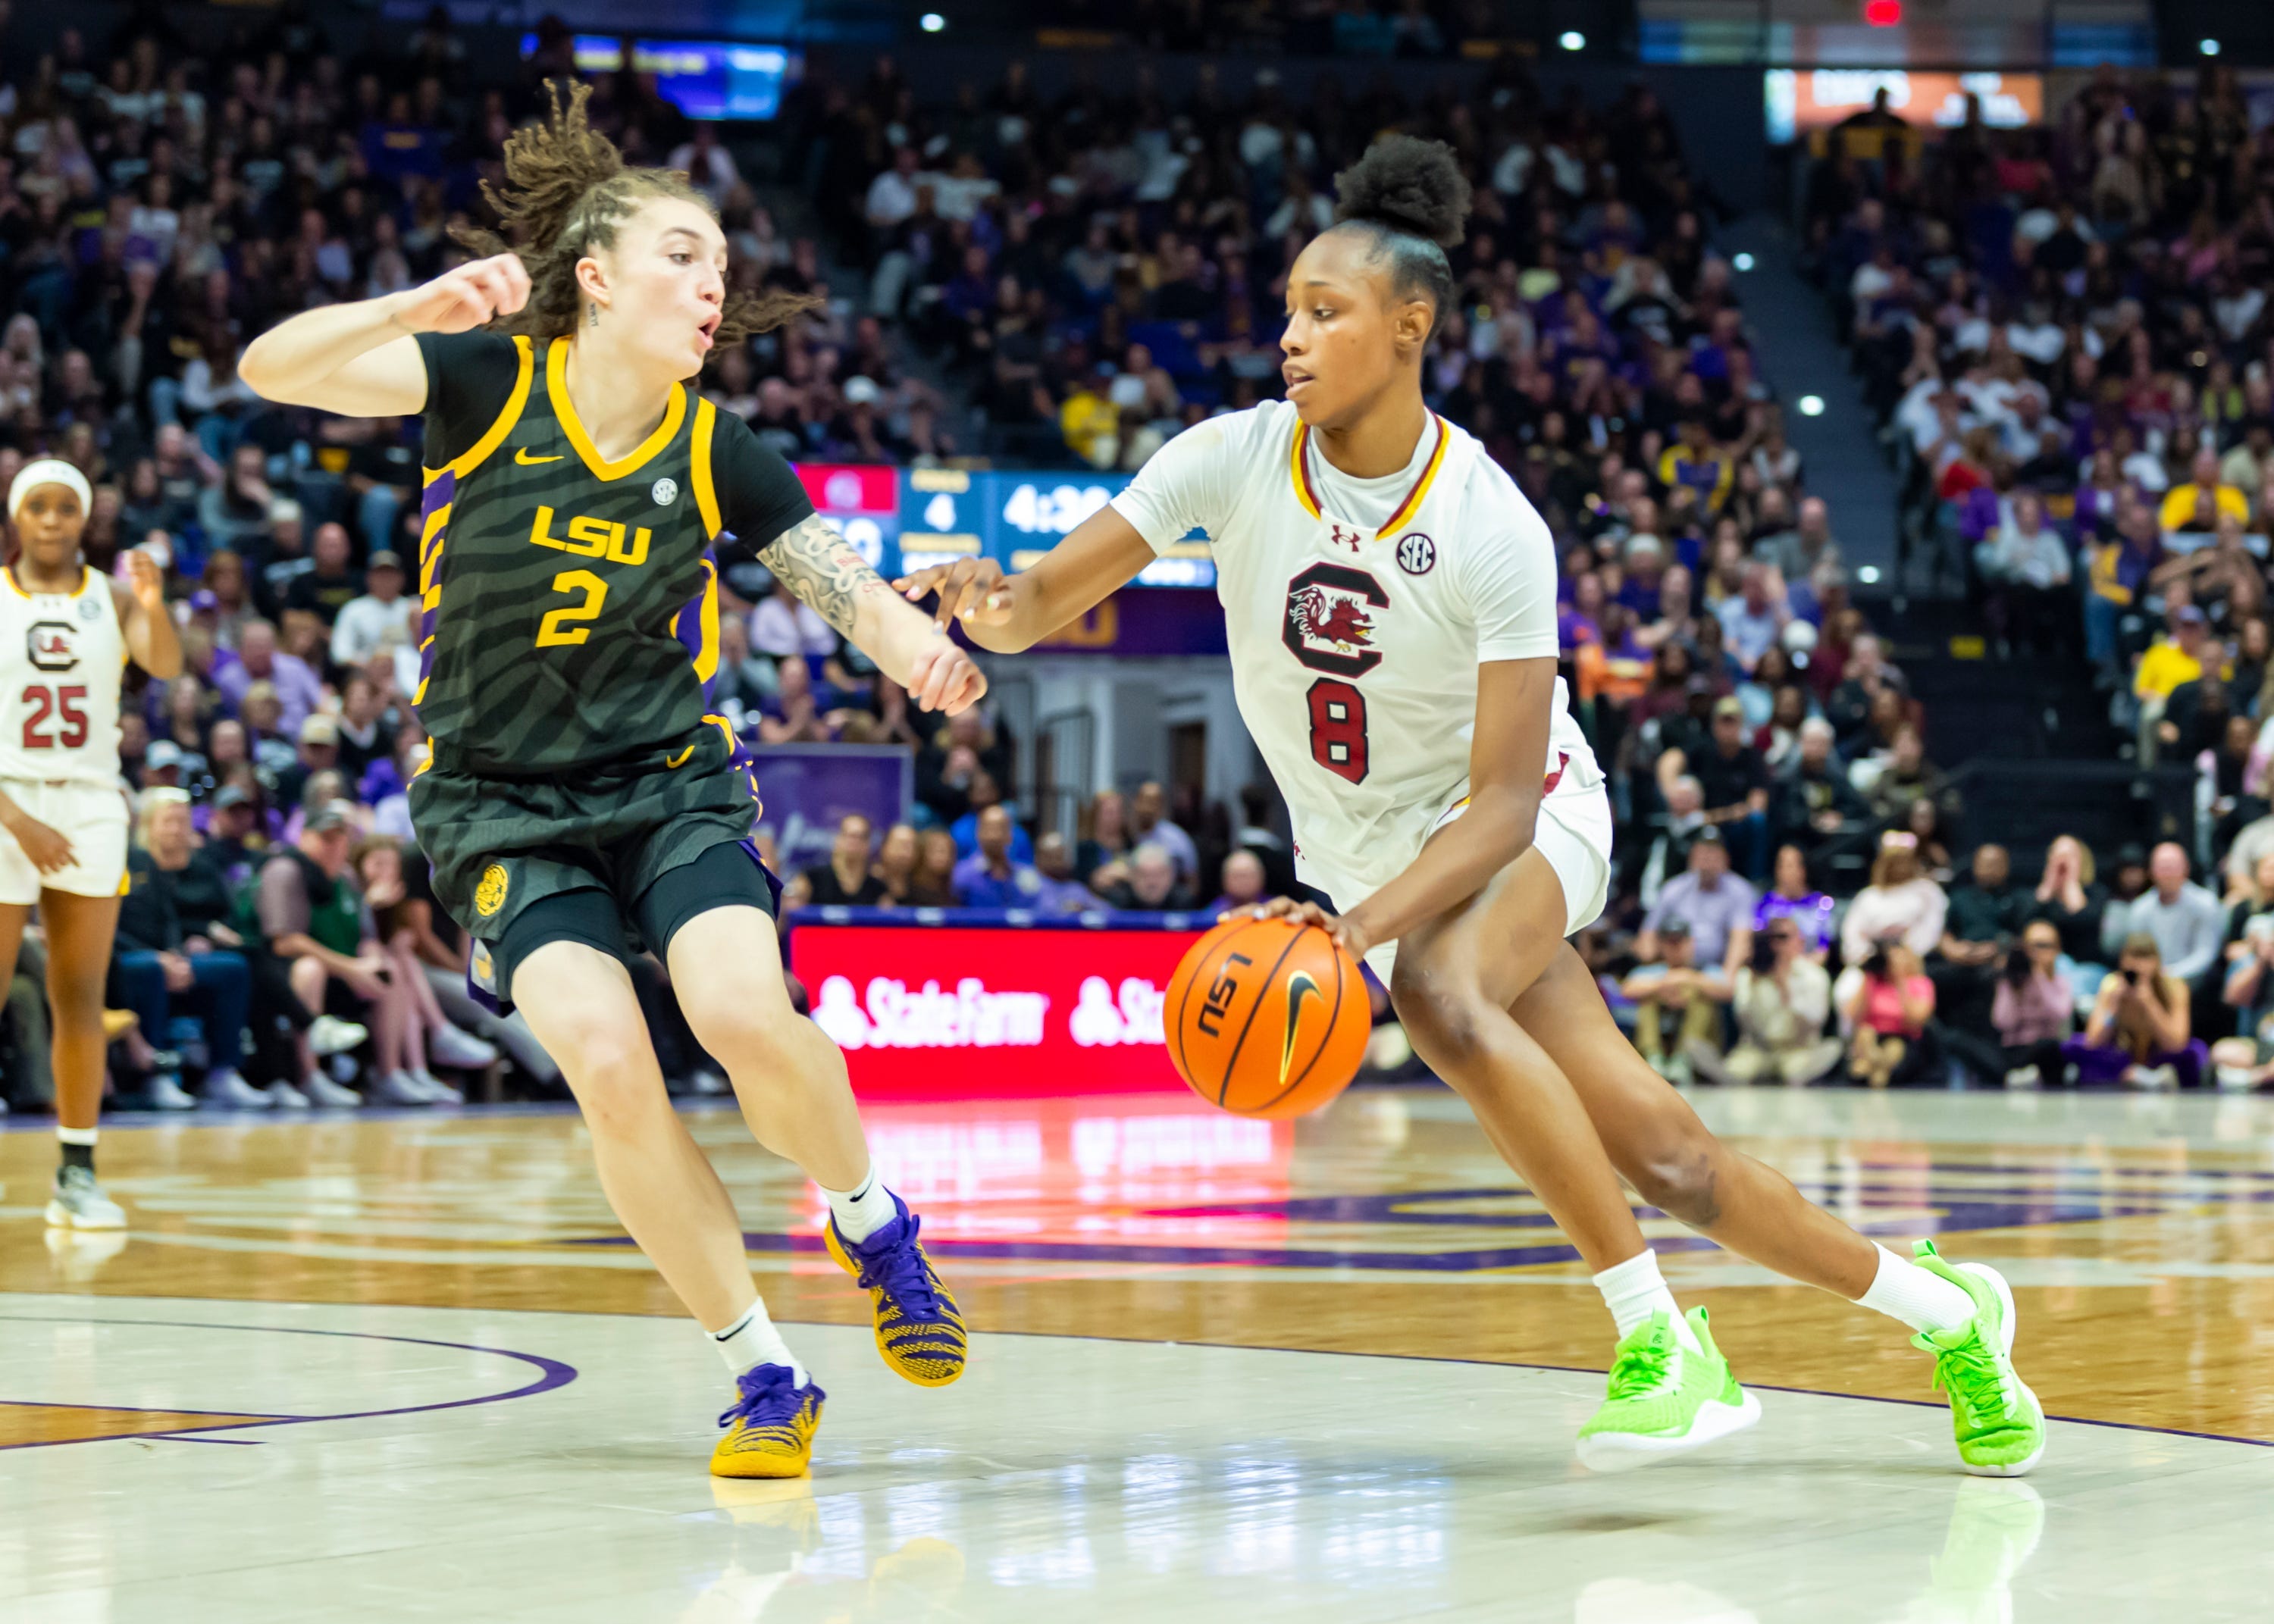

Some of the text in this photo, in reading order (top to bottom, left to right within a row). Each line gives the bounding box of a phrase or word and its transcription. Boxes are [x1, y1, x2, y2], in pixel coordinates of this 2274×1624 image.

[530, 505, 652, 565] LSU
[924, 493, 957, 531] 4
[1399, 535, 1434, 573] SEC
[535, 570, 609, 647] 2
[21, 685, 88, 748] 25
[1306, 677, 1370, 785] 8
[1198, 952, 1252, 1038] LSU
